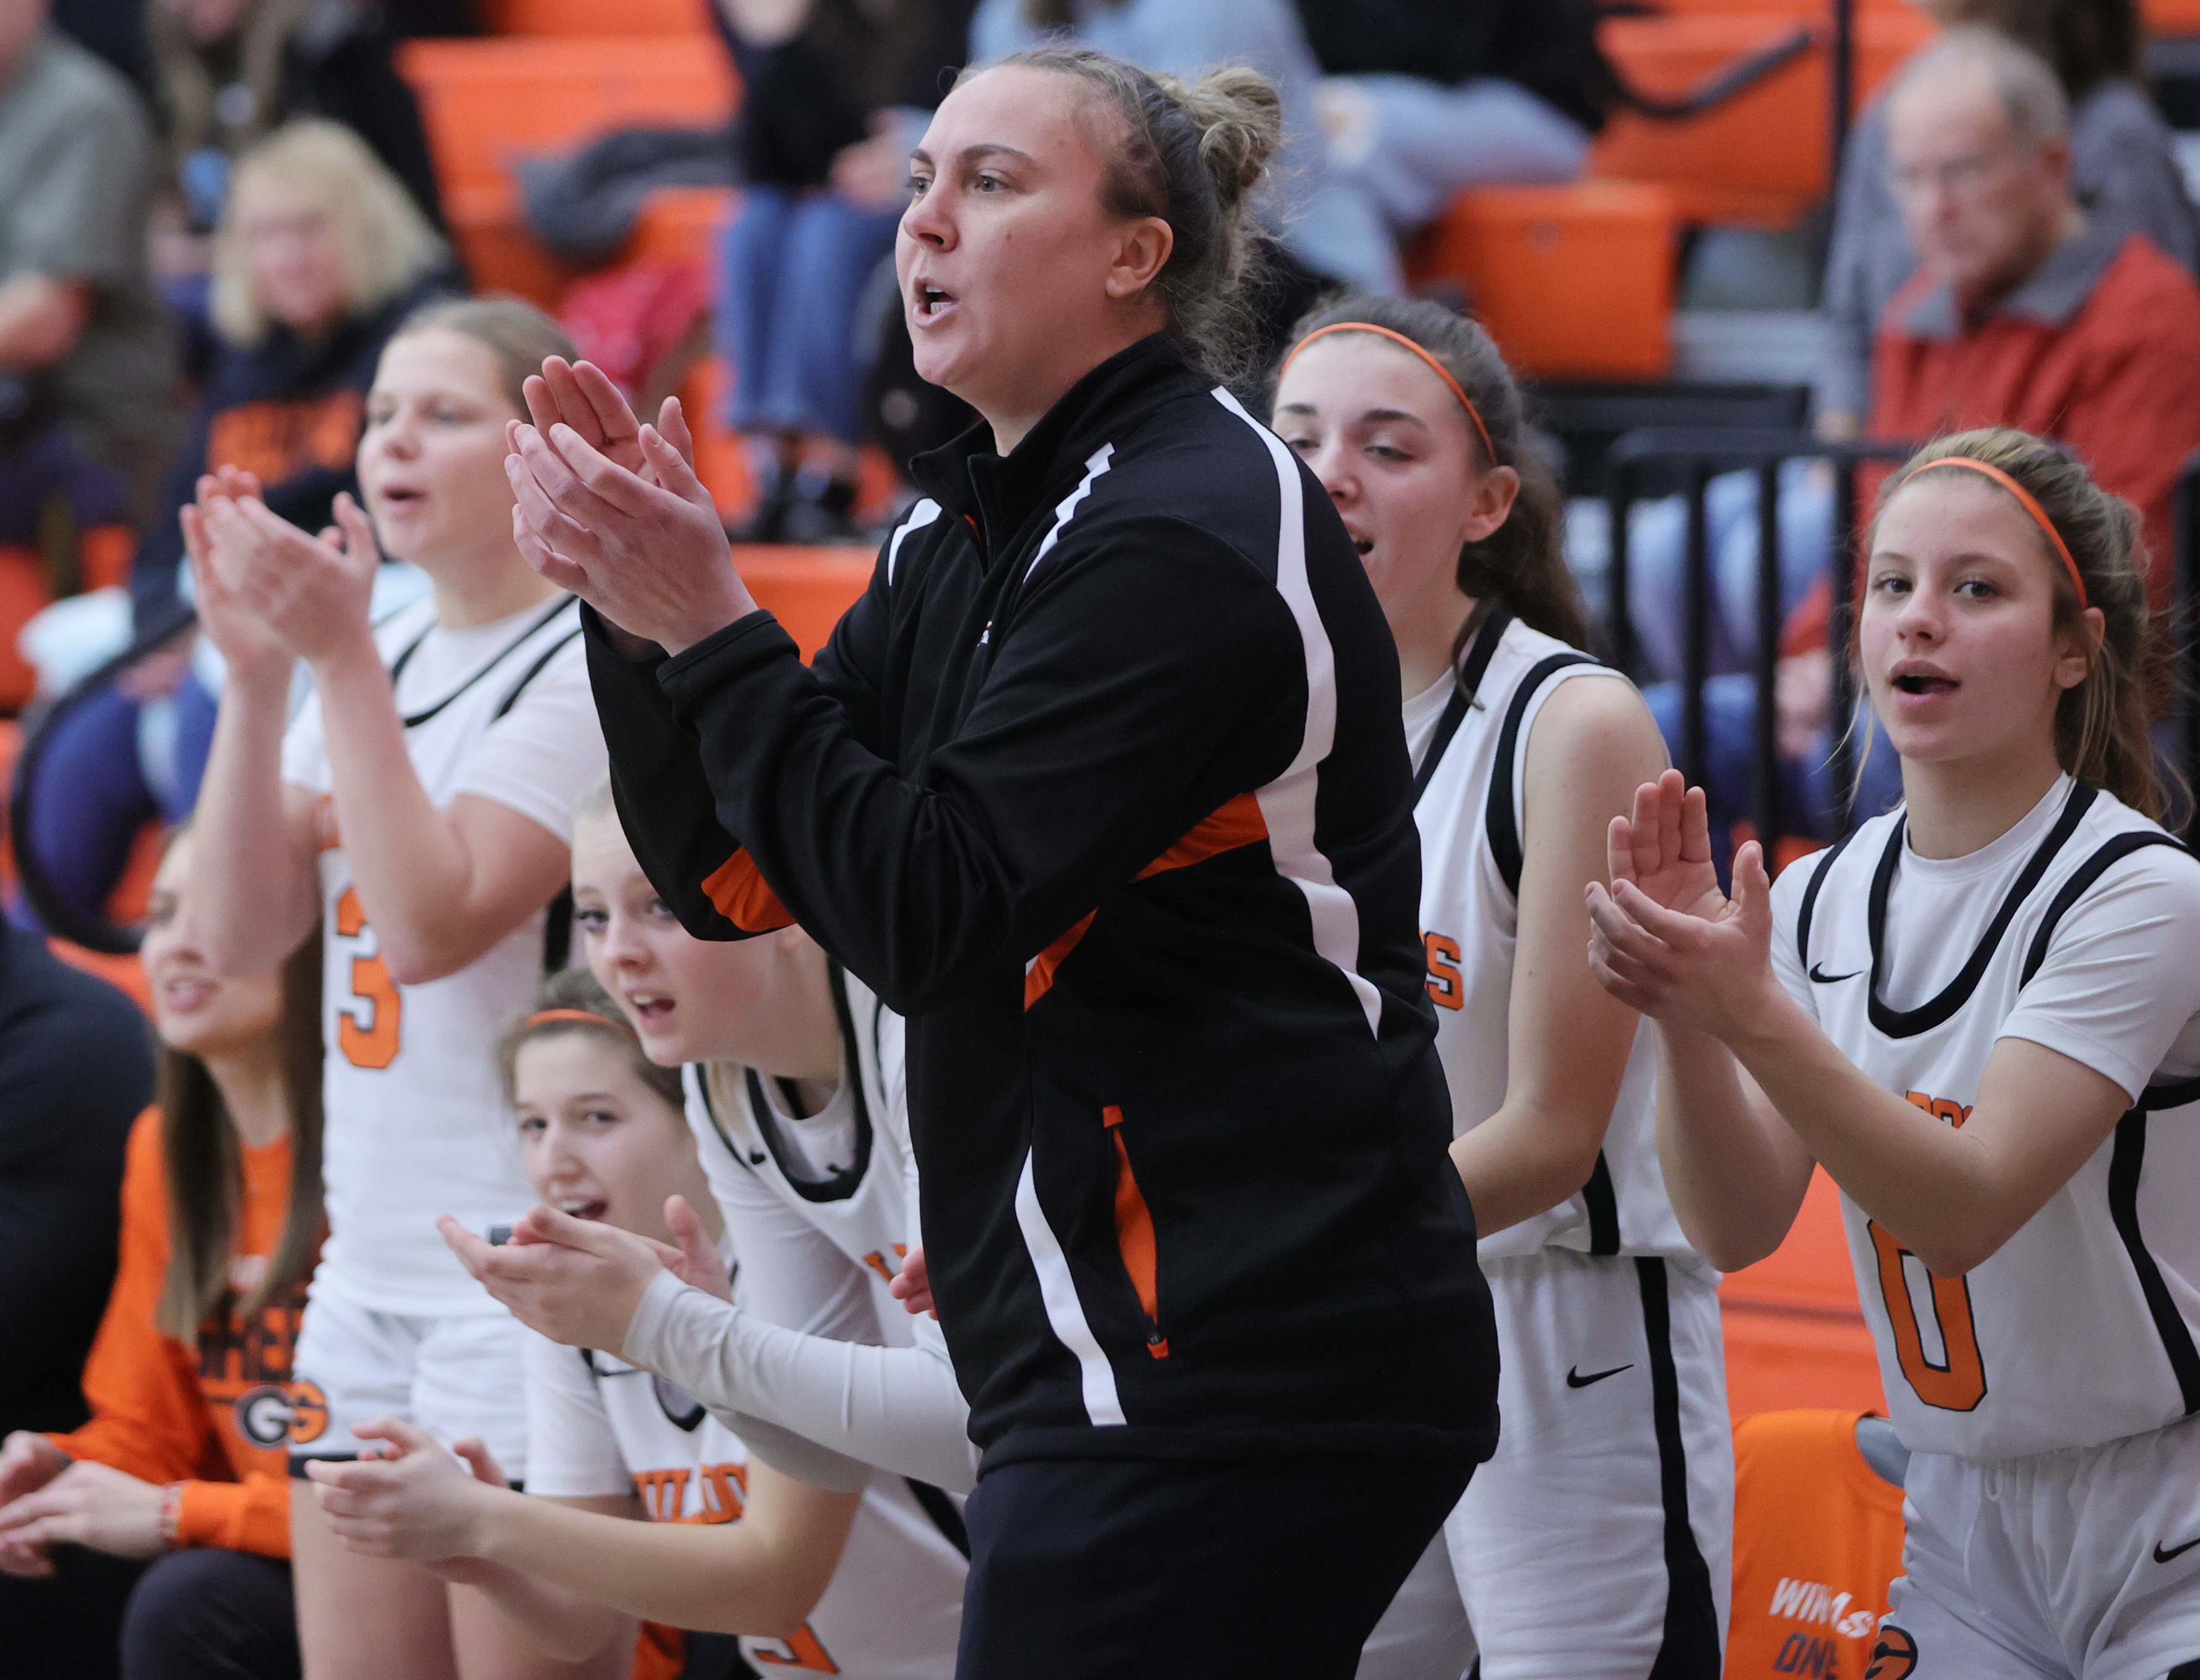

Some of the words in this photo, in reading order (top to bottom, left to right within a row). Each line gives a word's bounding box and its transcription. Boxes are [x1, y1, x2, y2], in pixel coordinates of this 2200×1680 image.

[337, 886, 403, 1069] 3
[1419, 927, 1464, 1011] S
[1867, 1219, 1988, 1412] 0
